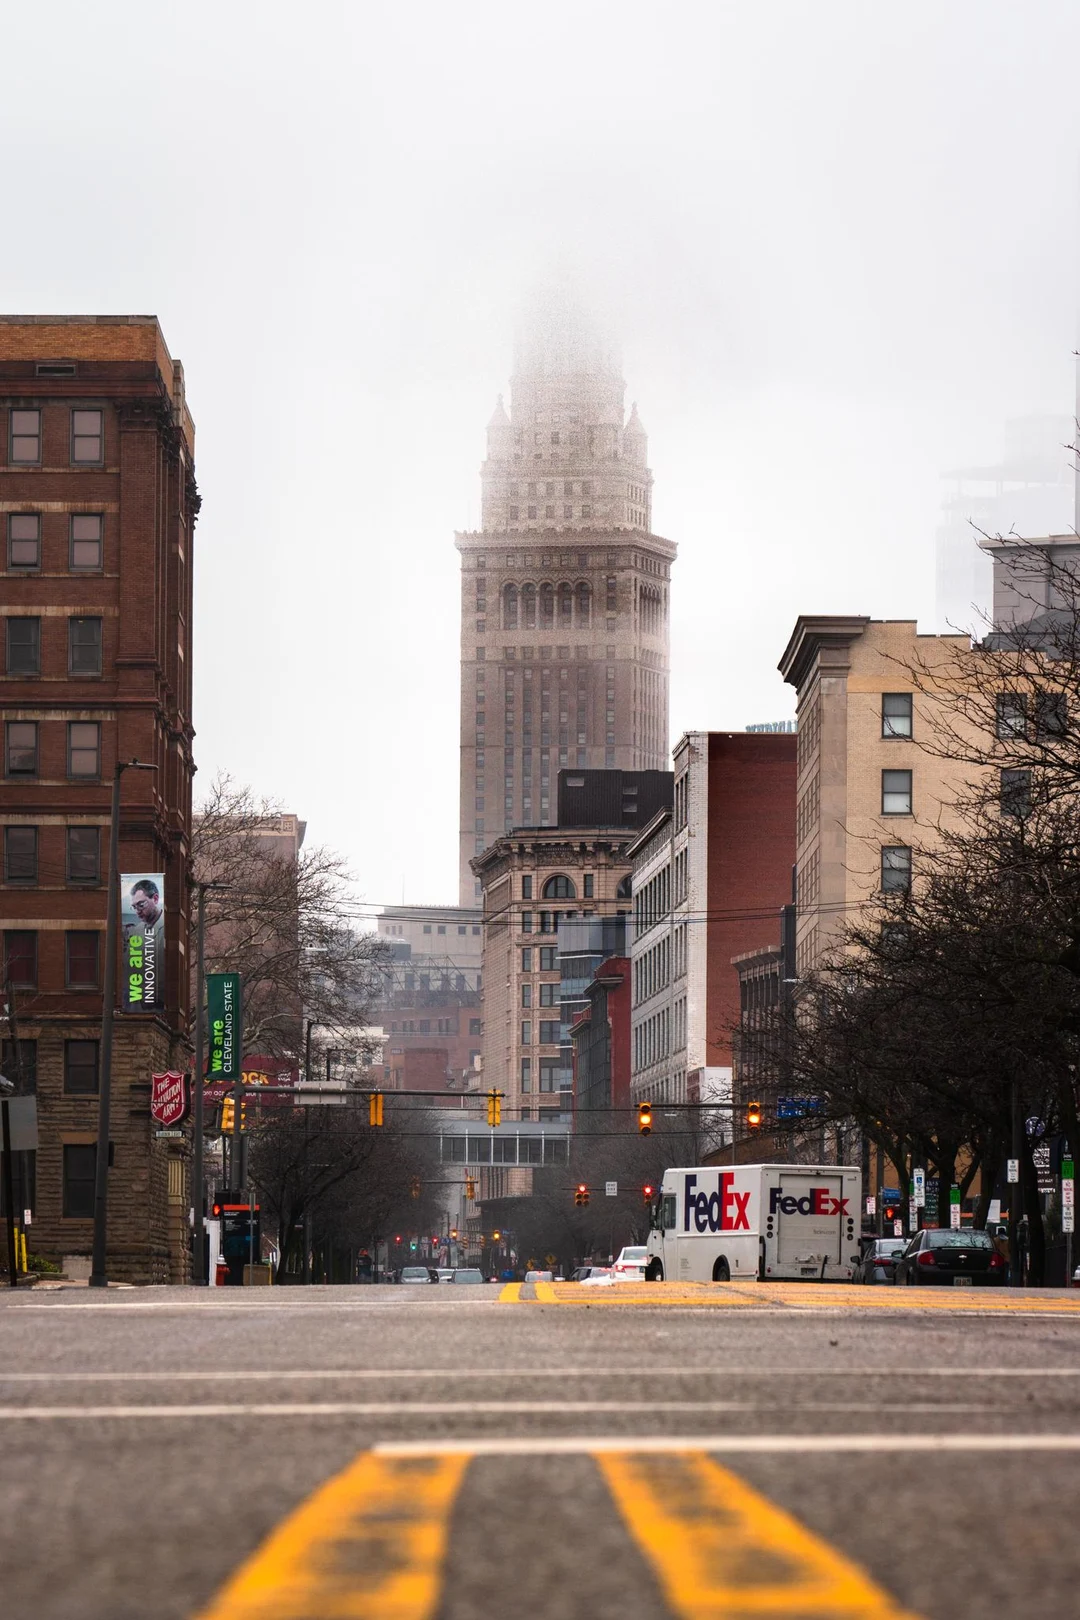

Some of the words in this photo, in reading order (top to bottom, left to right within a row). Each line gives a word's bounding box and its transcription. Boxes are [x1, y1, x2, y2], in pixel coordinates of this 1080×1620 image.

[129, 935, 143, 968] are
[144, 927, 155, 1003] INNOVATIVE
[129, 973, 143, 1003] we
[223, 981, 233, 1012] STATE
[213, 1020, 224, 1046] are
[223, 1013, 233, 1073] CLEVELAND
[212, 1049, 223, 1072] we
[153, 1079, 180, 1112] SALVATION
[157, 1077, 169, 1094] THE
[162, 1095, 180, 1119] ARMY
[685, 1172, 751, 1233] FedEx
[769, 1187, 850, 1216] FedEx
